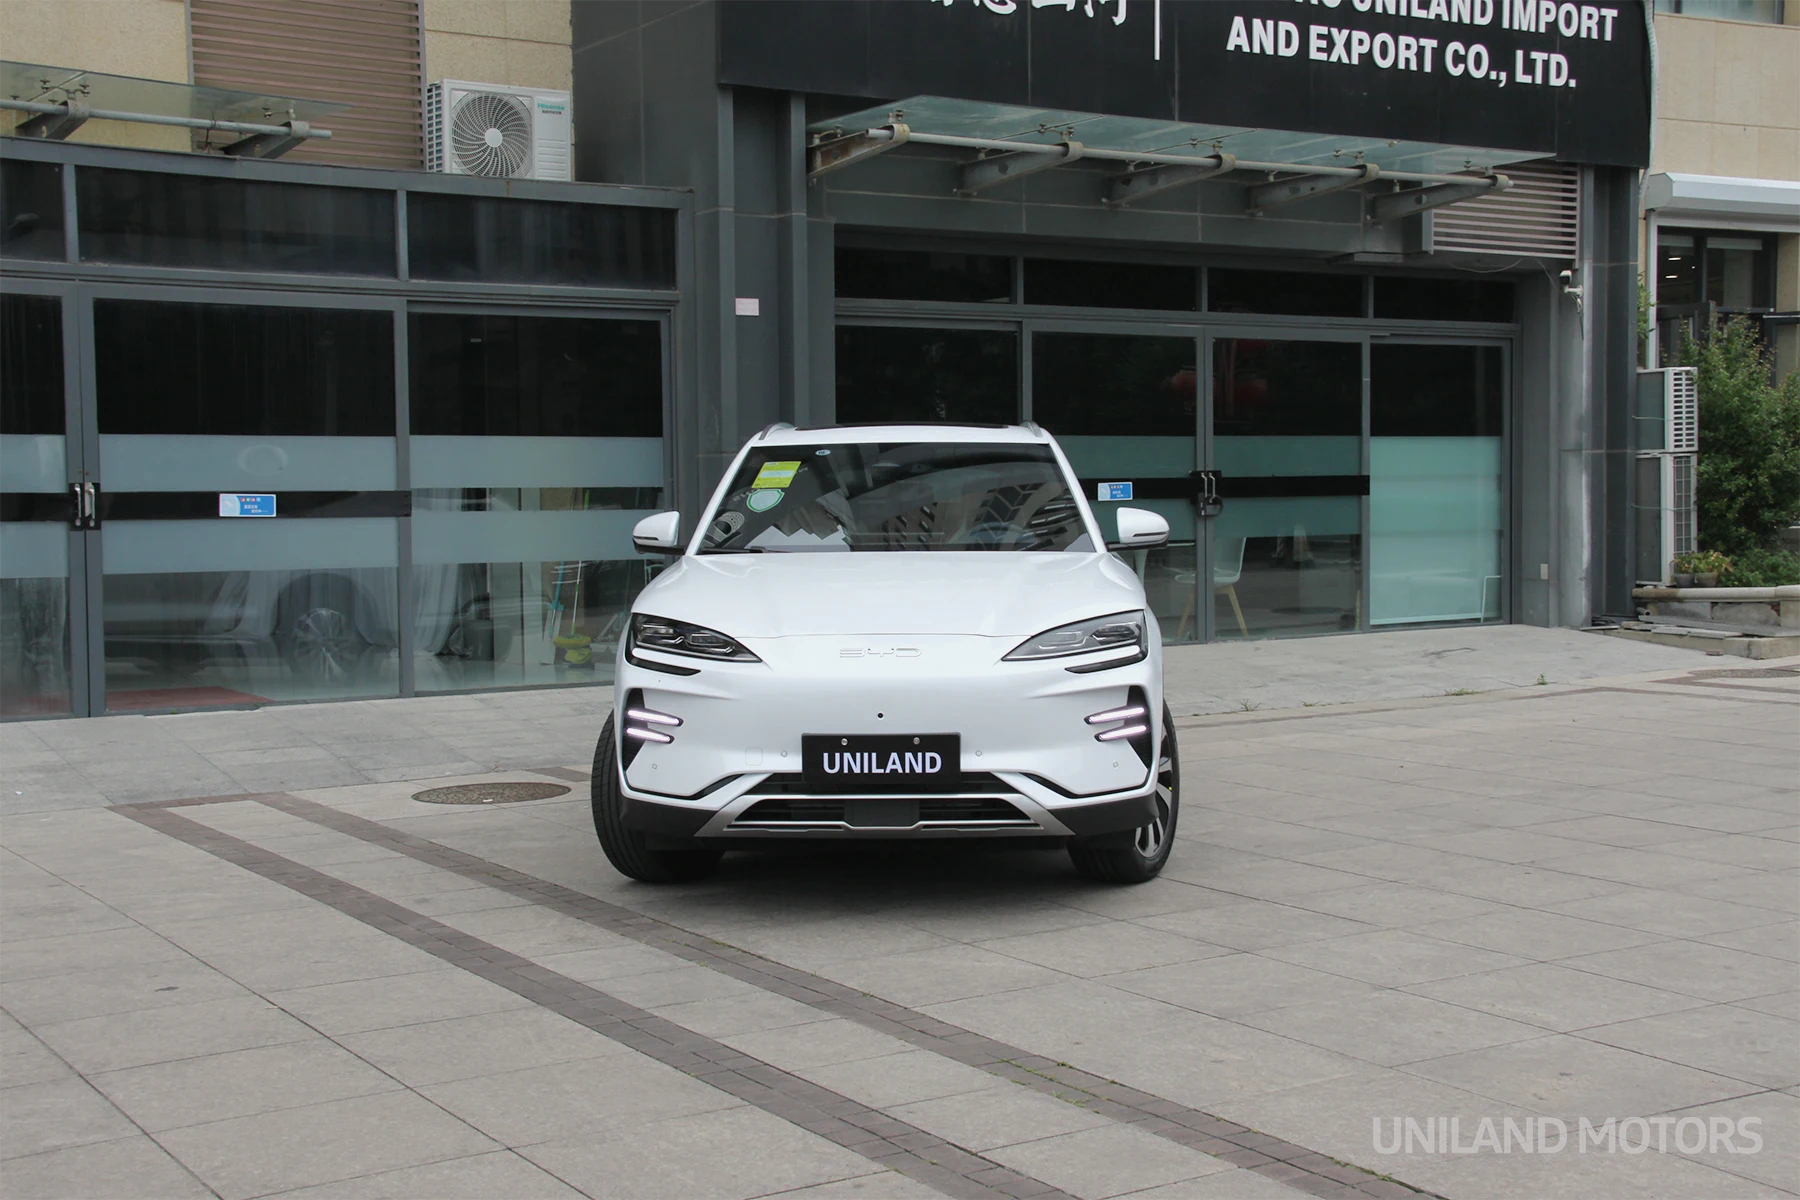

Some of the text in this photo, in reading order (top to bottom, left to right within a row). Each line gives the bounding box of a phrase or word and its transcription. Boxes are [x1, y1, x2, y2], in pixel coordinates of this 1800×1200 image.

[1501, 0, 1619, 41] IMPORT
[1225, 16, 1577, 88] AND EXPORT CO., LTD.
[840, 647, 921, 658] BYD
[823, 752, 942, 774] UNILAND
